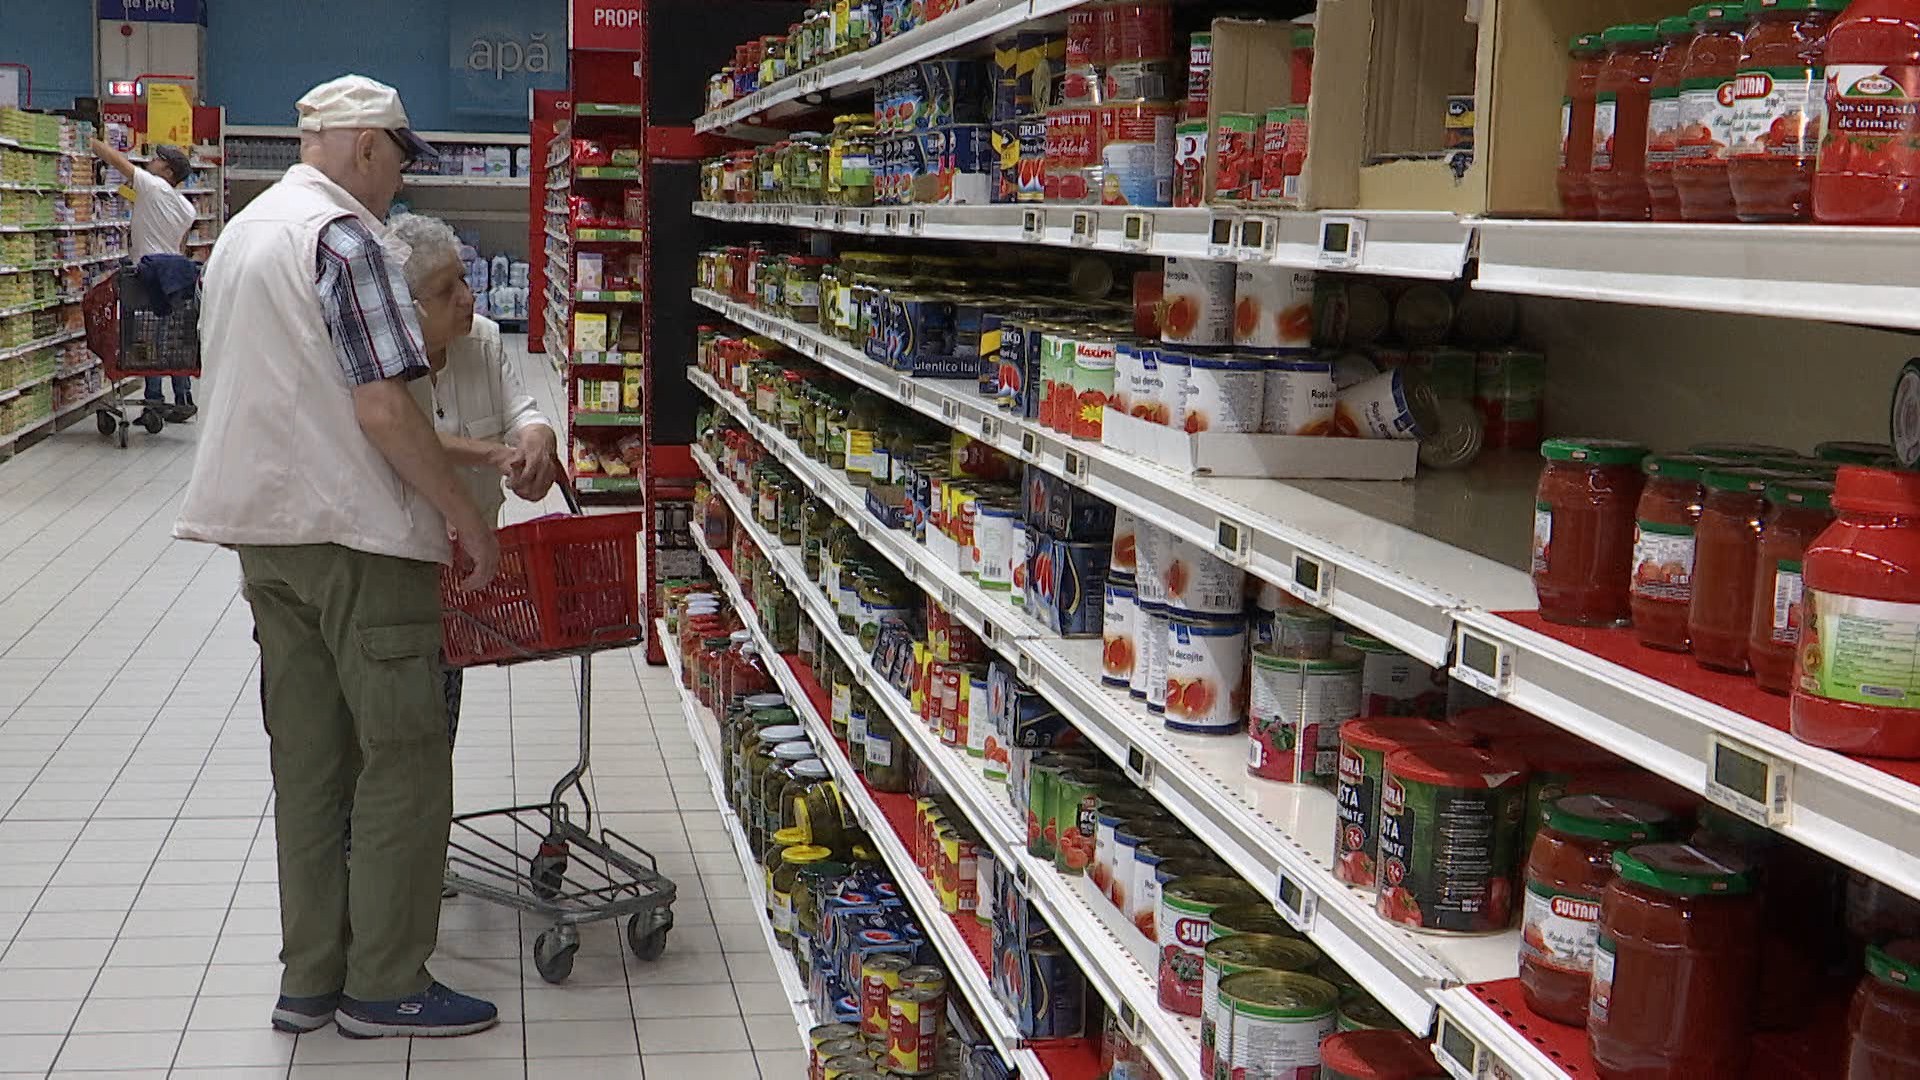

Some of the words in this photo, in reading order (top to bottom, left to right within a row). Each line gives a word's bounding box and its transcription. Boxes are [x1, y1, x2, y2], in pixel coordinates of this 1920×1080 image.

[594, 8, 642, 27] PROP
[468, 32, 550, 80] apă
[1836, 102, 1855, 112] Sos
[1857, 103, 1873, 113] cu
[1839, 116, 1854, 128] de
[1856, 117, 1907, 129] tomate
[1555, 899, 1599, 920] SULTAN
